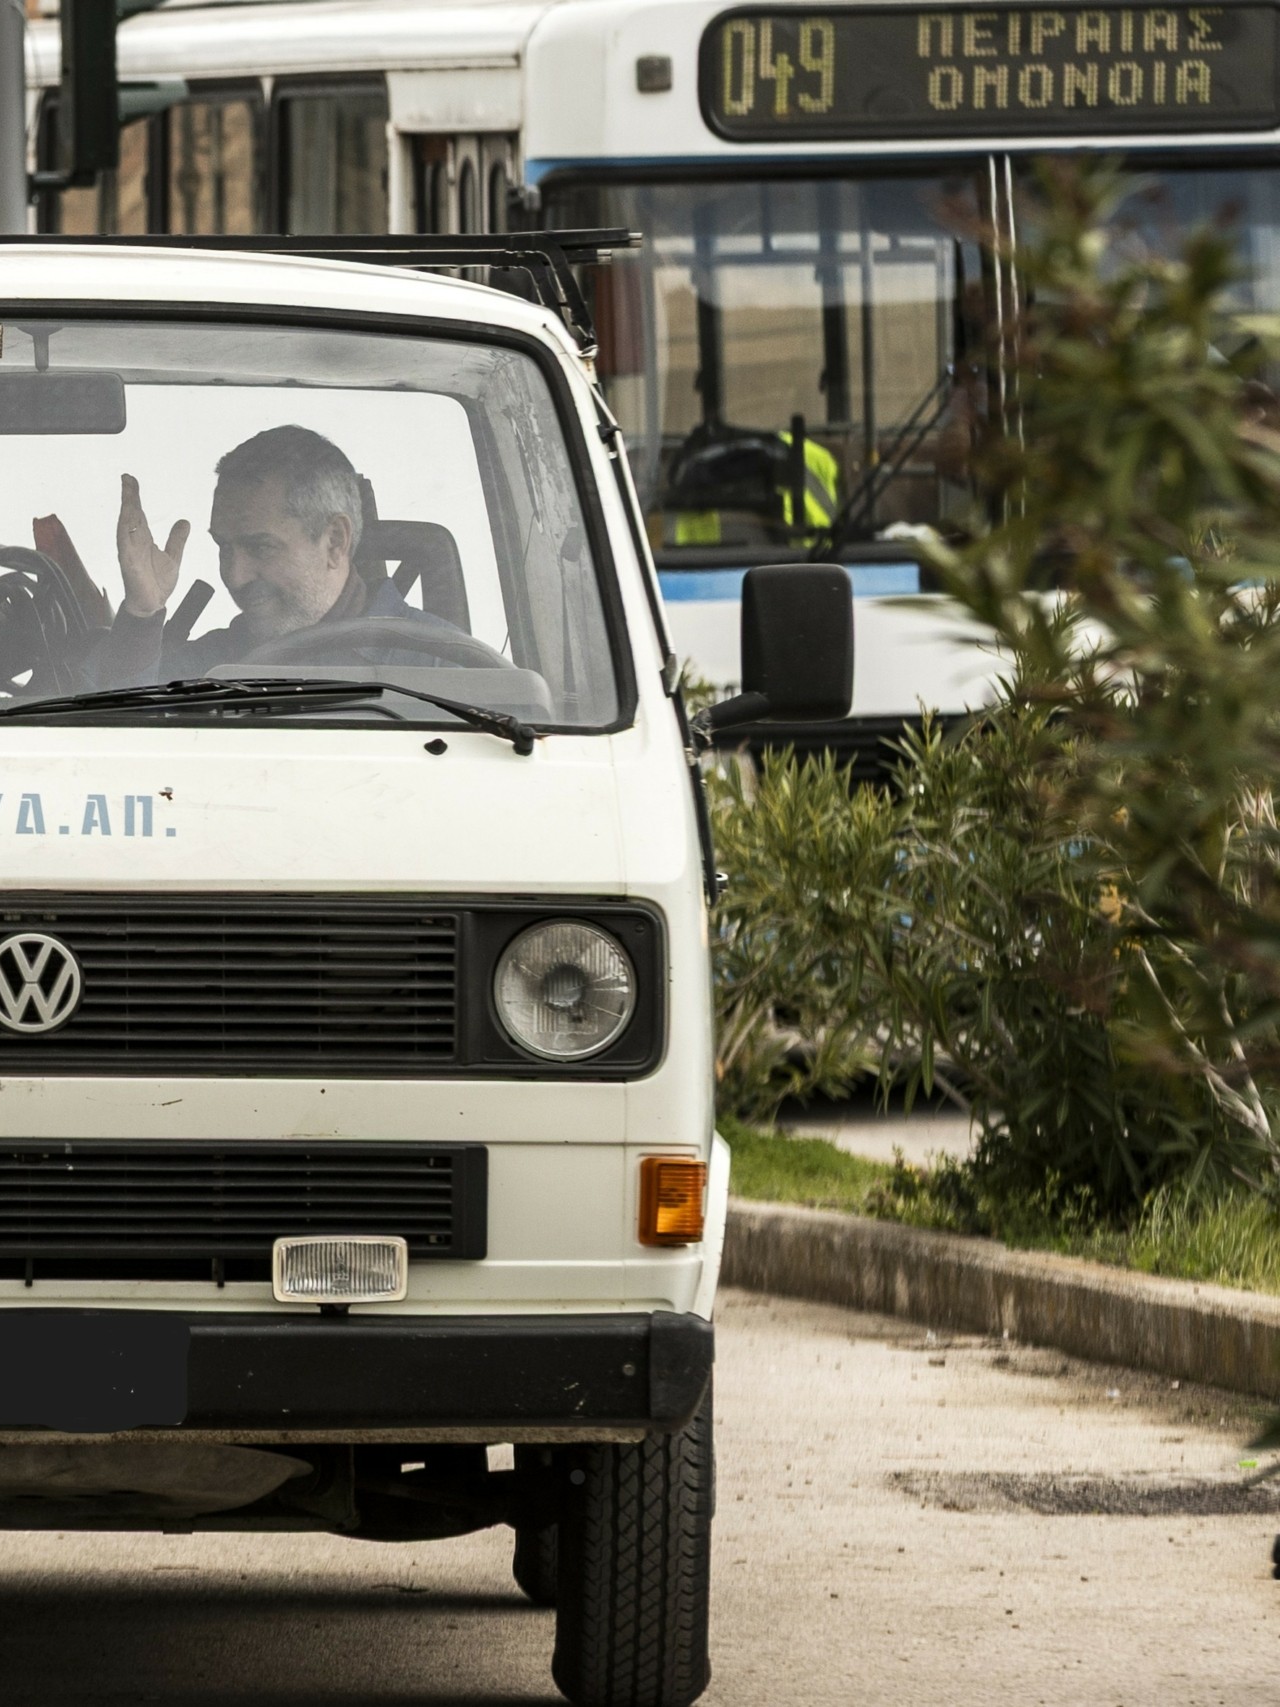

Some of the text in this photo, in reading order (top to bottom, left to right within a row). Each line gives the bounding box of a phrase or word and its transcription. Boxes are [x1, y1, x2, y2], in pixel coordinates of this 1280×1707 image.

[918, 8, 1223, 58] ΠΕΙΡΑΙΑΣ
[723, 18, 834, 116] 049
[927, 59, 1212, 112] ΟΜΟΝΟΙΑ
